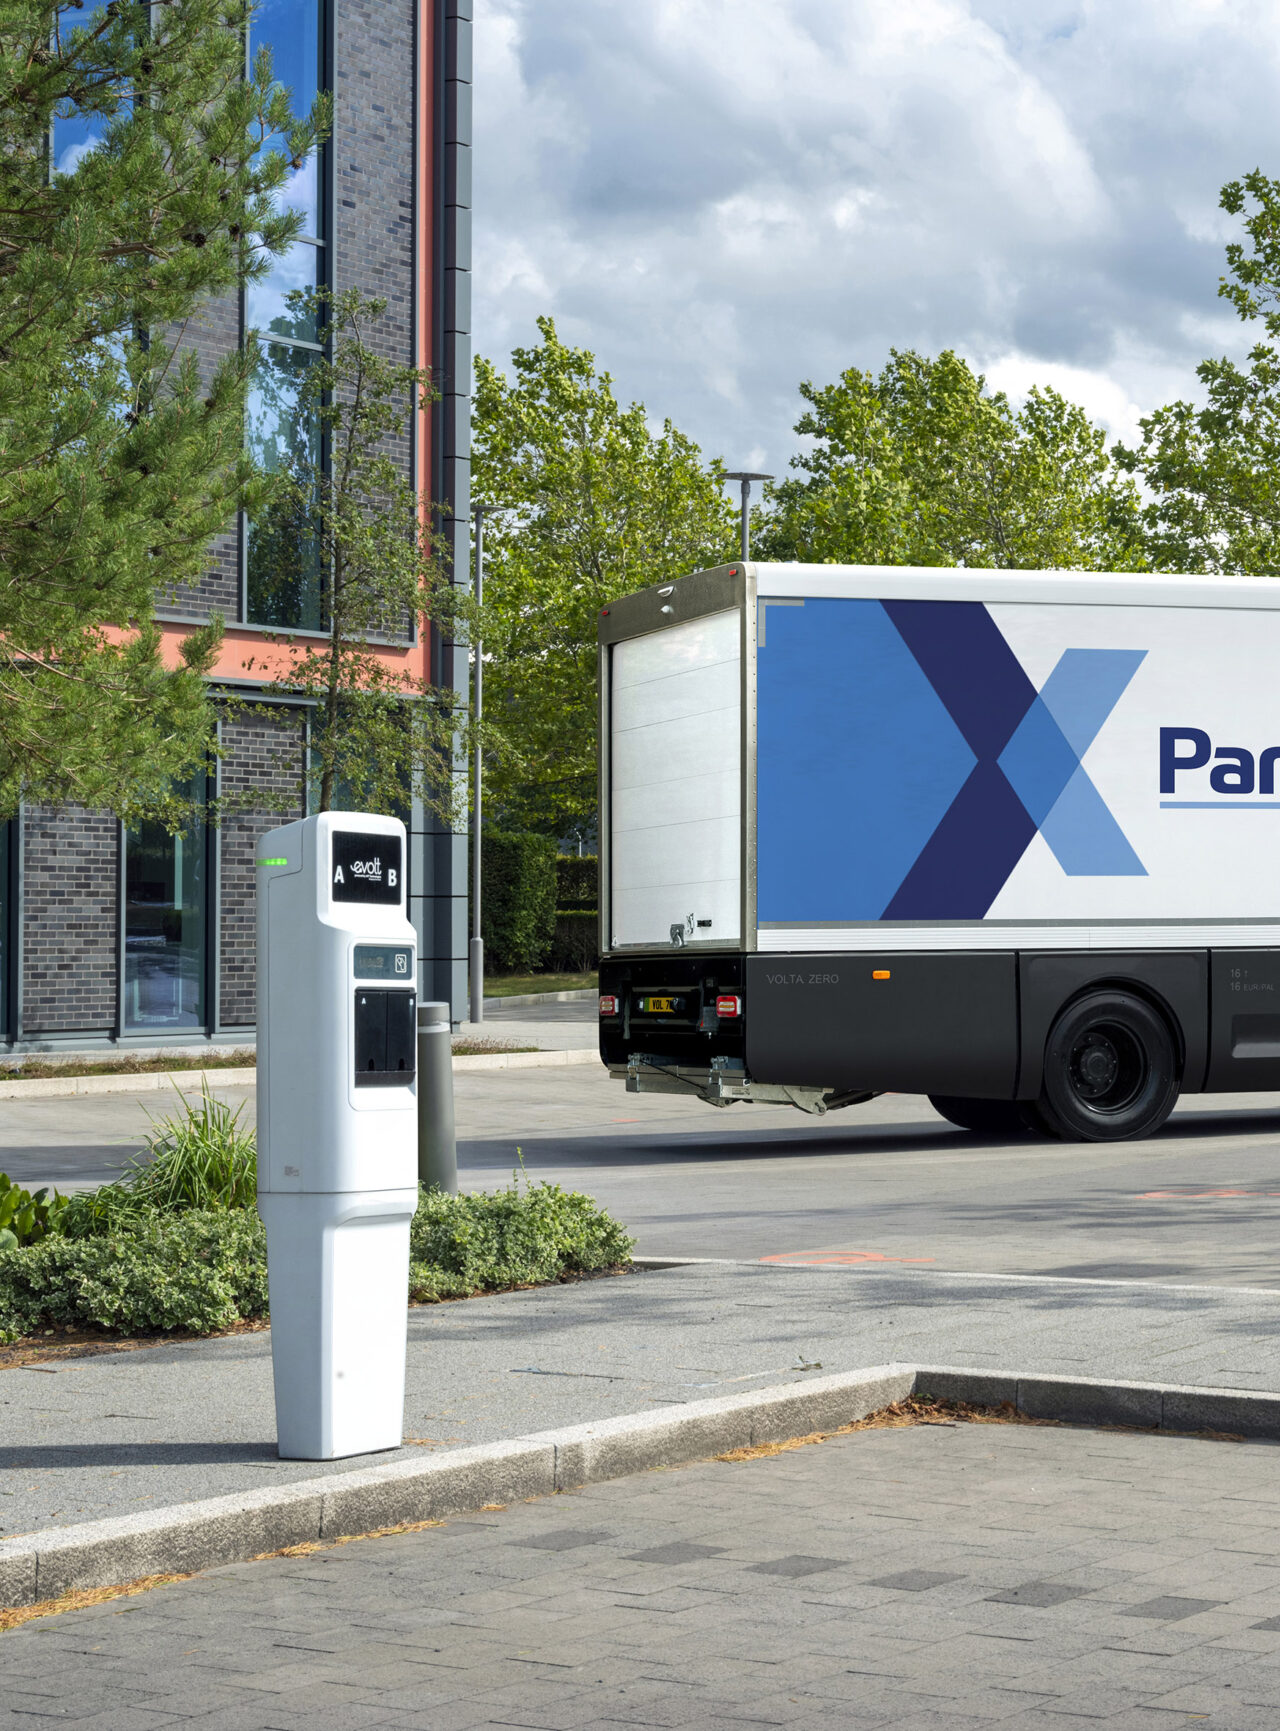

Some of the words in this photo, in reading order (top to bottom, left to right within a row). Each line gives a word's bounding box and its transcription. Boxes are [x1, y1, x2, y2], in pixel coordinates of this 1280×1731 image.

[334, 865, 345, 884] A
[387, 868, 398, 887] B
[765, 974, 805, 985] VOLTA
[808, 974, 840, 984] ZERO
[652, 999, 664, 1010] VOL
